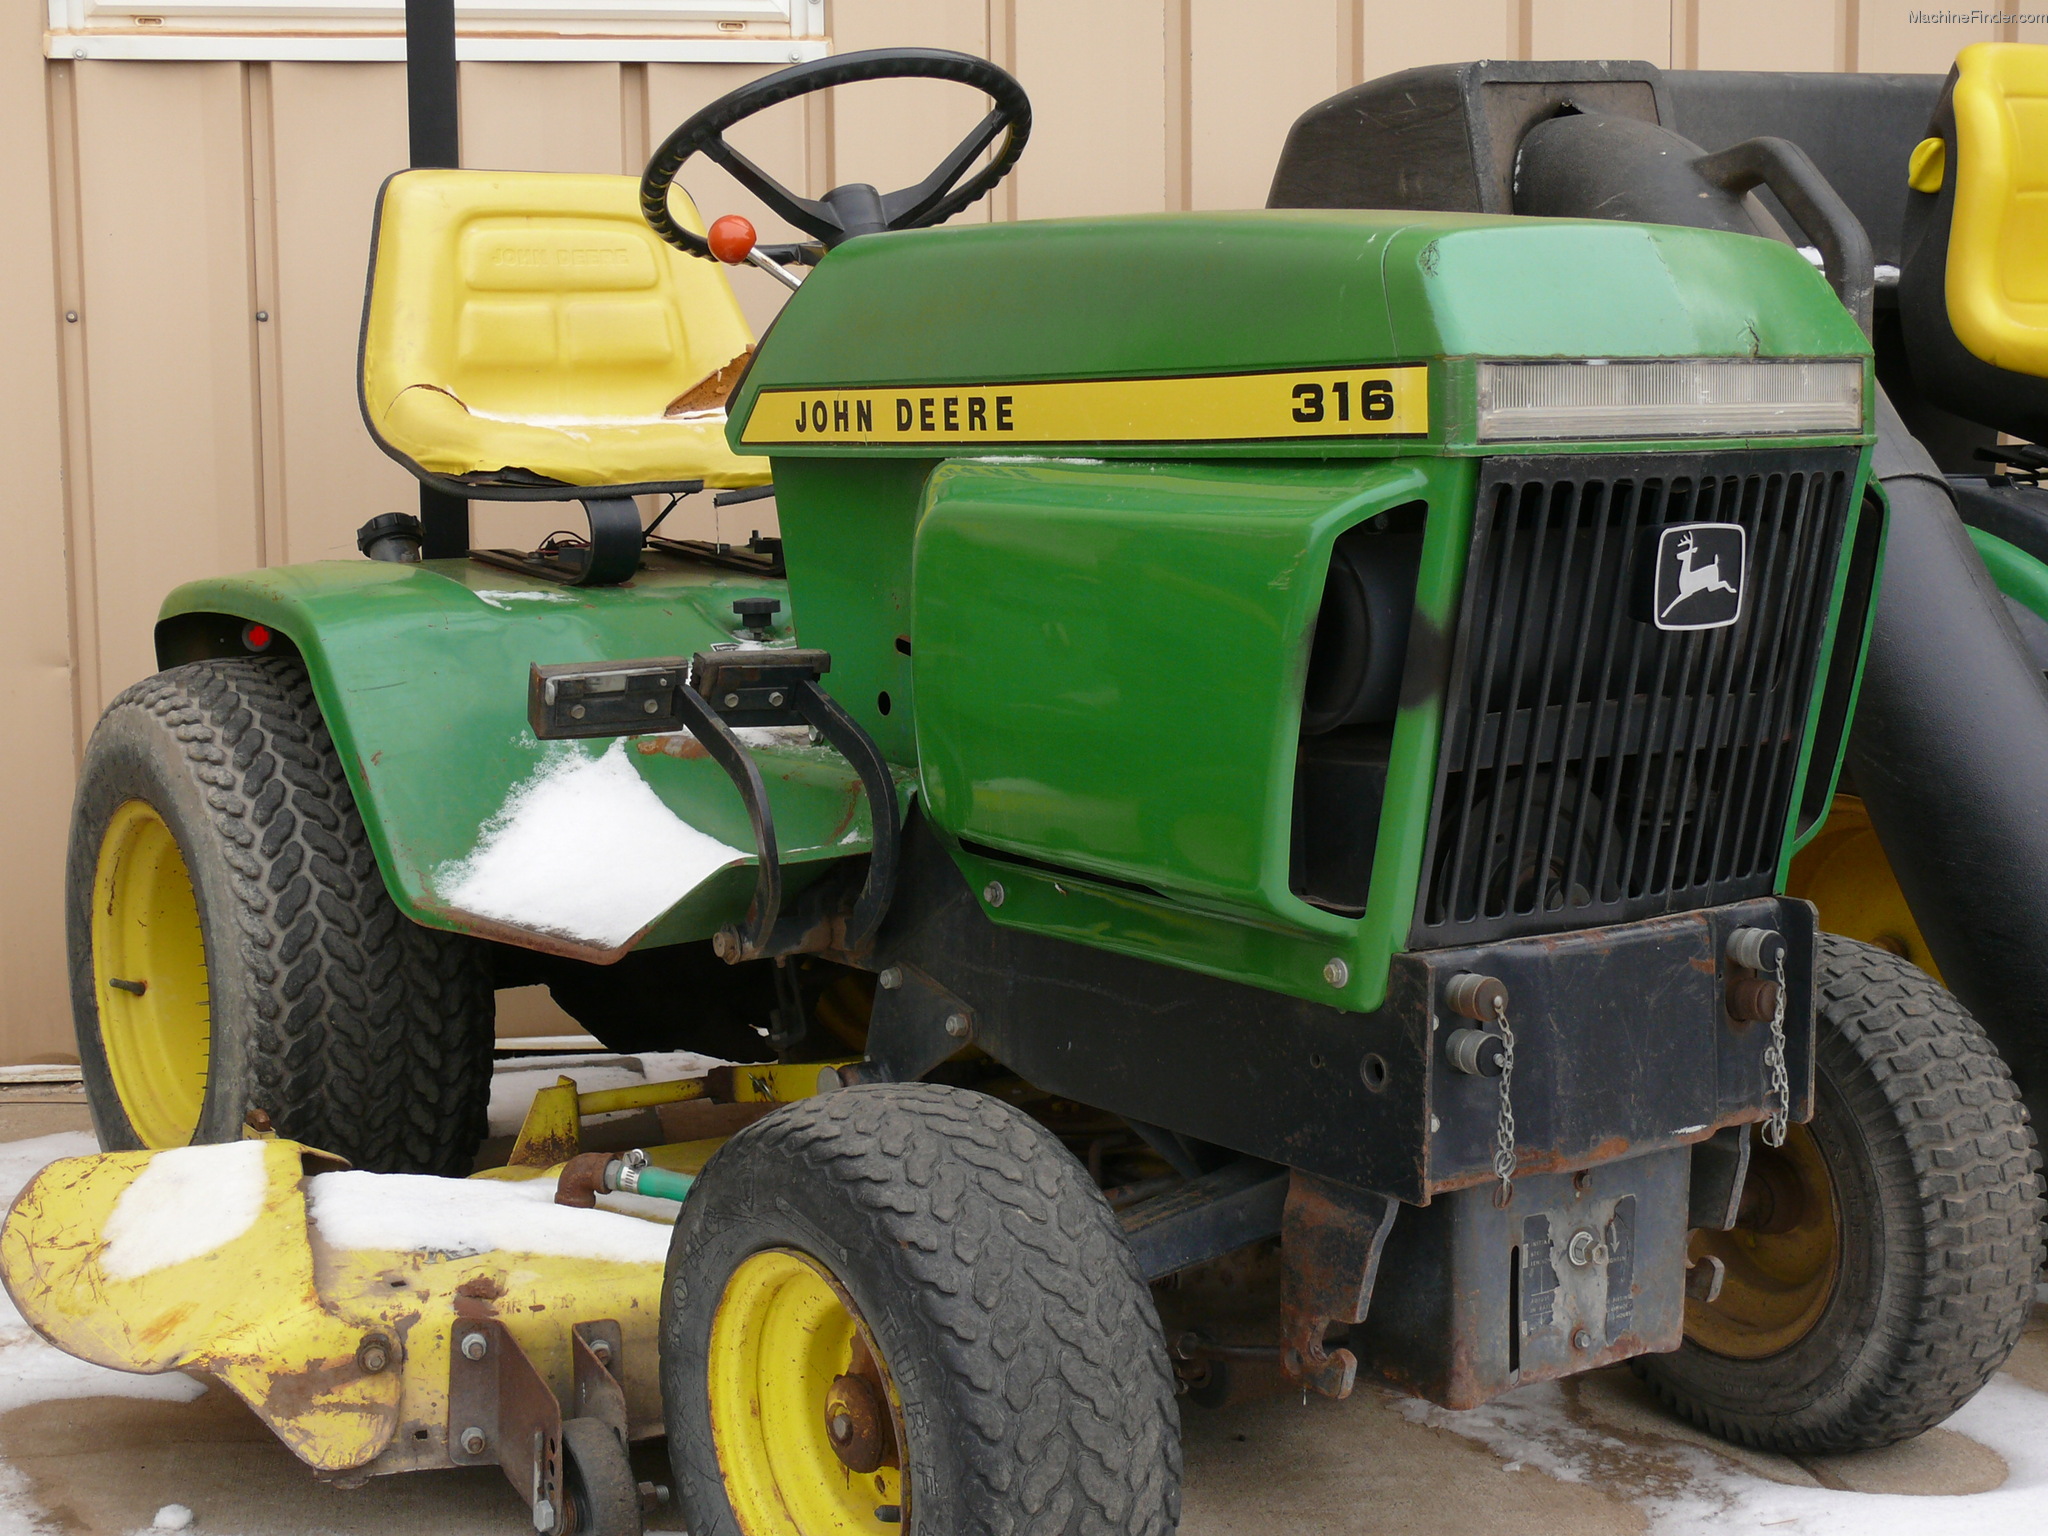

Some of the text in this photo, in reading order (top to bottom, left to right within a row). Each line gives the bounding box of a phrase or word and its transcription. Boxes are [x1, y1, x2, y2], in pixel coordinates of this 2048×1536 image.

[493, 247, 630, 267] JOHN DEERE
[795, 379, 1395, 433] JOHN DEERE 316
